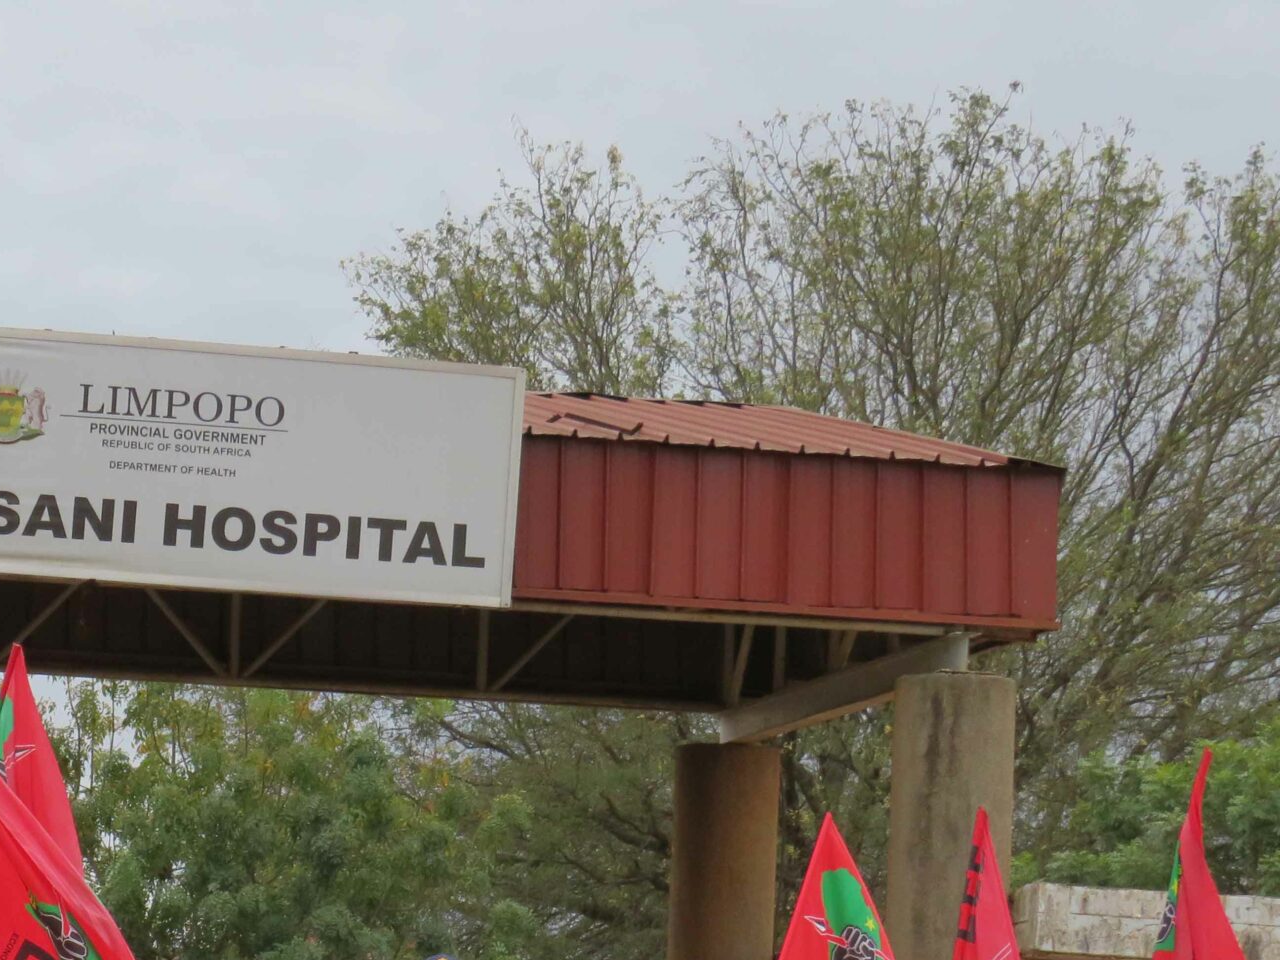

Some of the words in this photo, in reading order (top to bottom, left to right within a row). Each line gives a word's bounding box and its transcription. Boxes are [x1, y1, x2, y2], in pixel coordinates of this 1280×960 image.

[77, 384, 286, 427] LIMPOPO
[89, 422, 170, 439] PROVINCIAL
[173, 429, 267, 446] GOVERNMENT
[101, 439, 154, 451] REPUBLIC
[157, 443, 172, 452] OF
[174, 444, 210, 455] SOUTH
[213, 447, 252, 458] AFRICA
[109, 460, 177, 474] DEPARTMENT
[180, 465, 195, 475] OF
[197, 467, 236, 478] HEALTH
[163, 503, 486, 568] HOSPITAL
